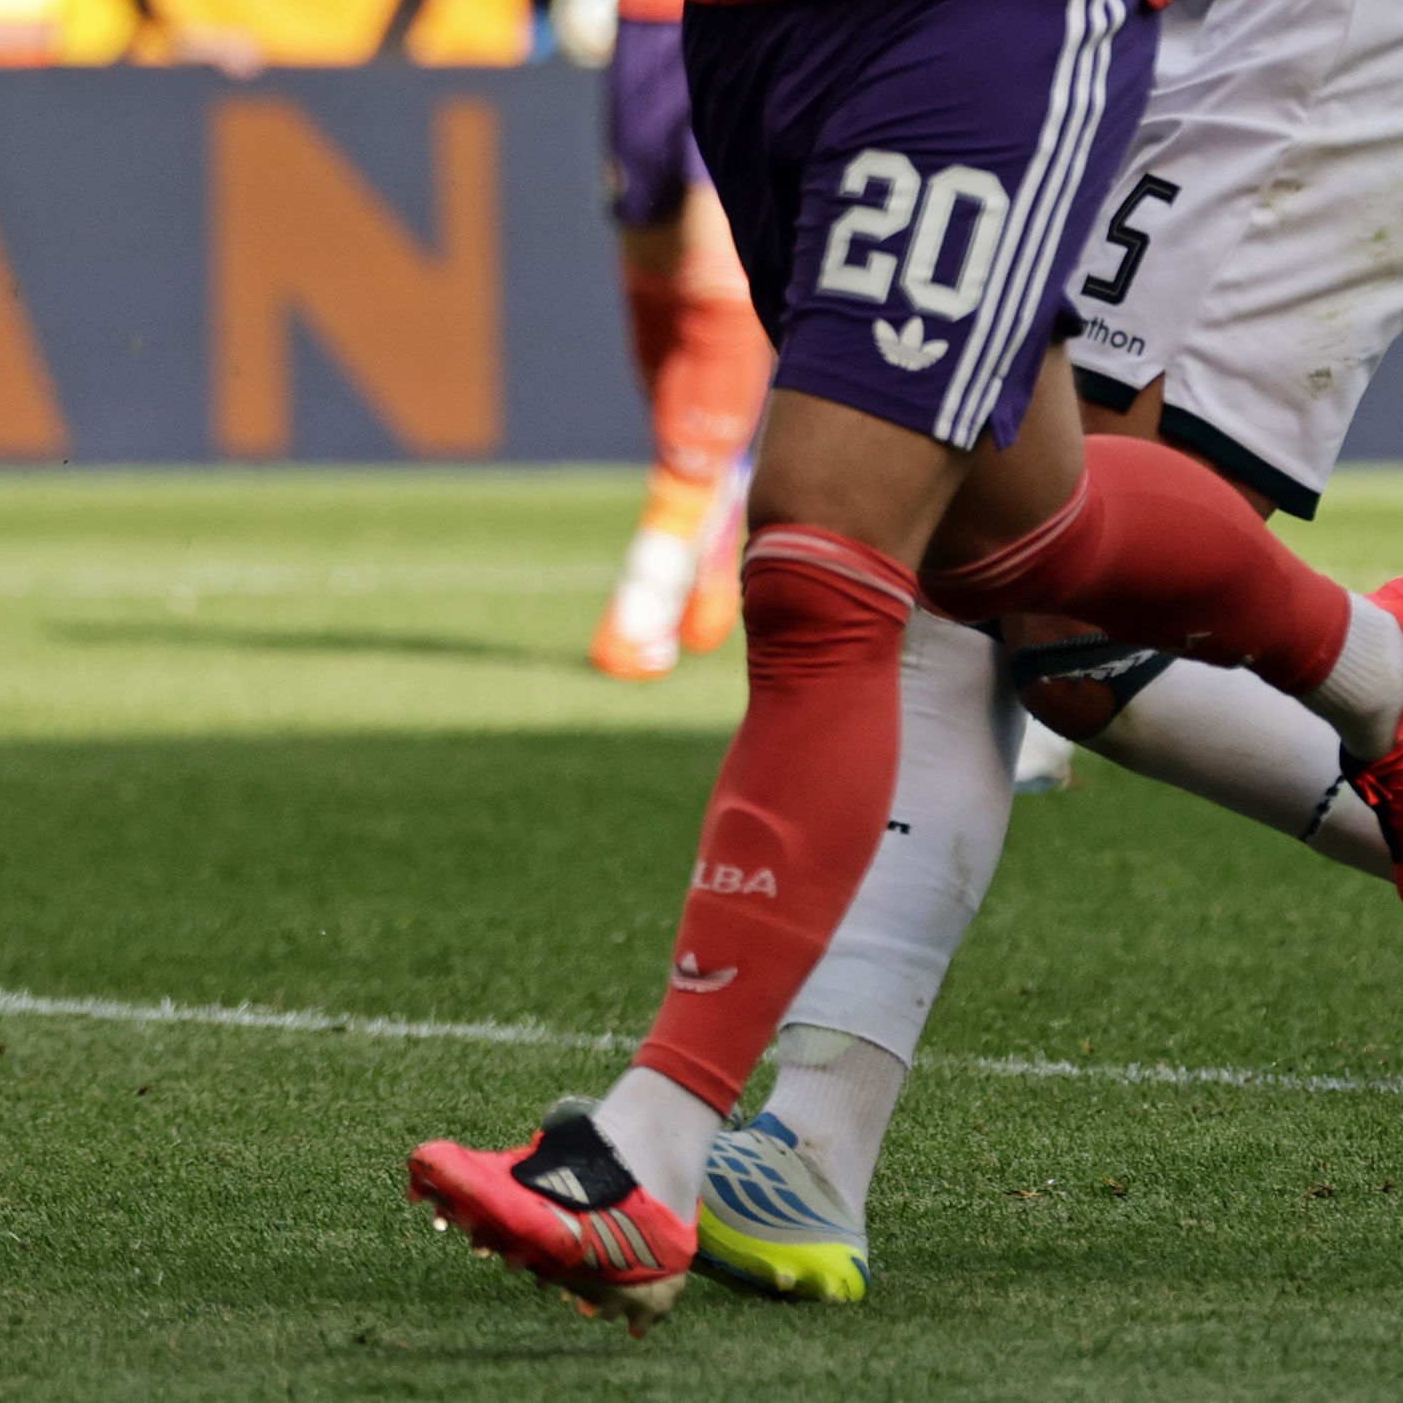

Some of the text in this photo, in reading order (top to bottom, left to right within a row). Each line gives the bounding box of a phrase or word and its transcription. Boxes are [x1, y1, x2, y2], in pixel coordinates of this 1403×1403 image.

[817, 149, 1011, 323] 20
[1081, 173, 1181, 306] 5
[1082, 316, 1146, 357] thon
